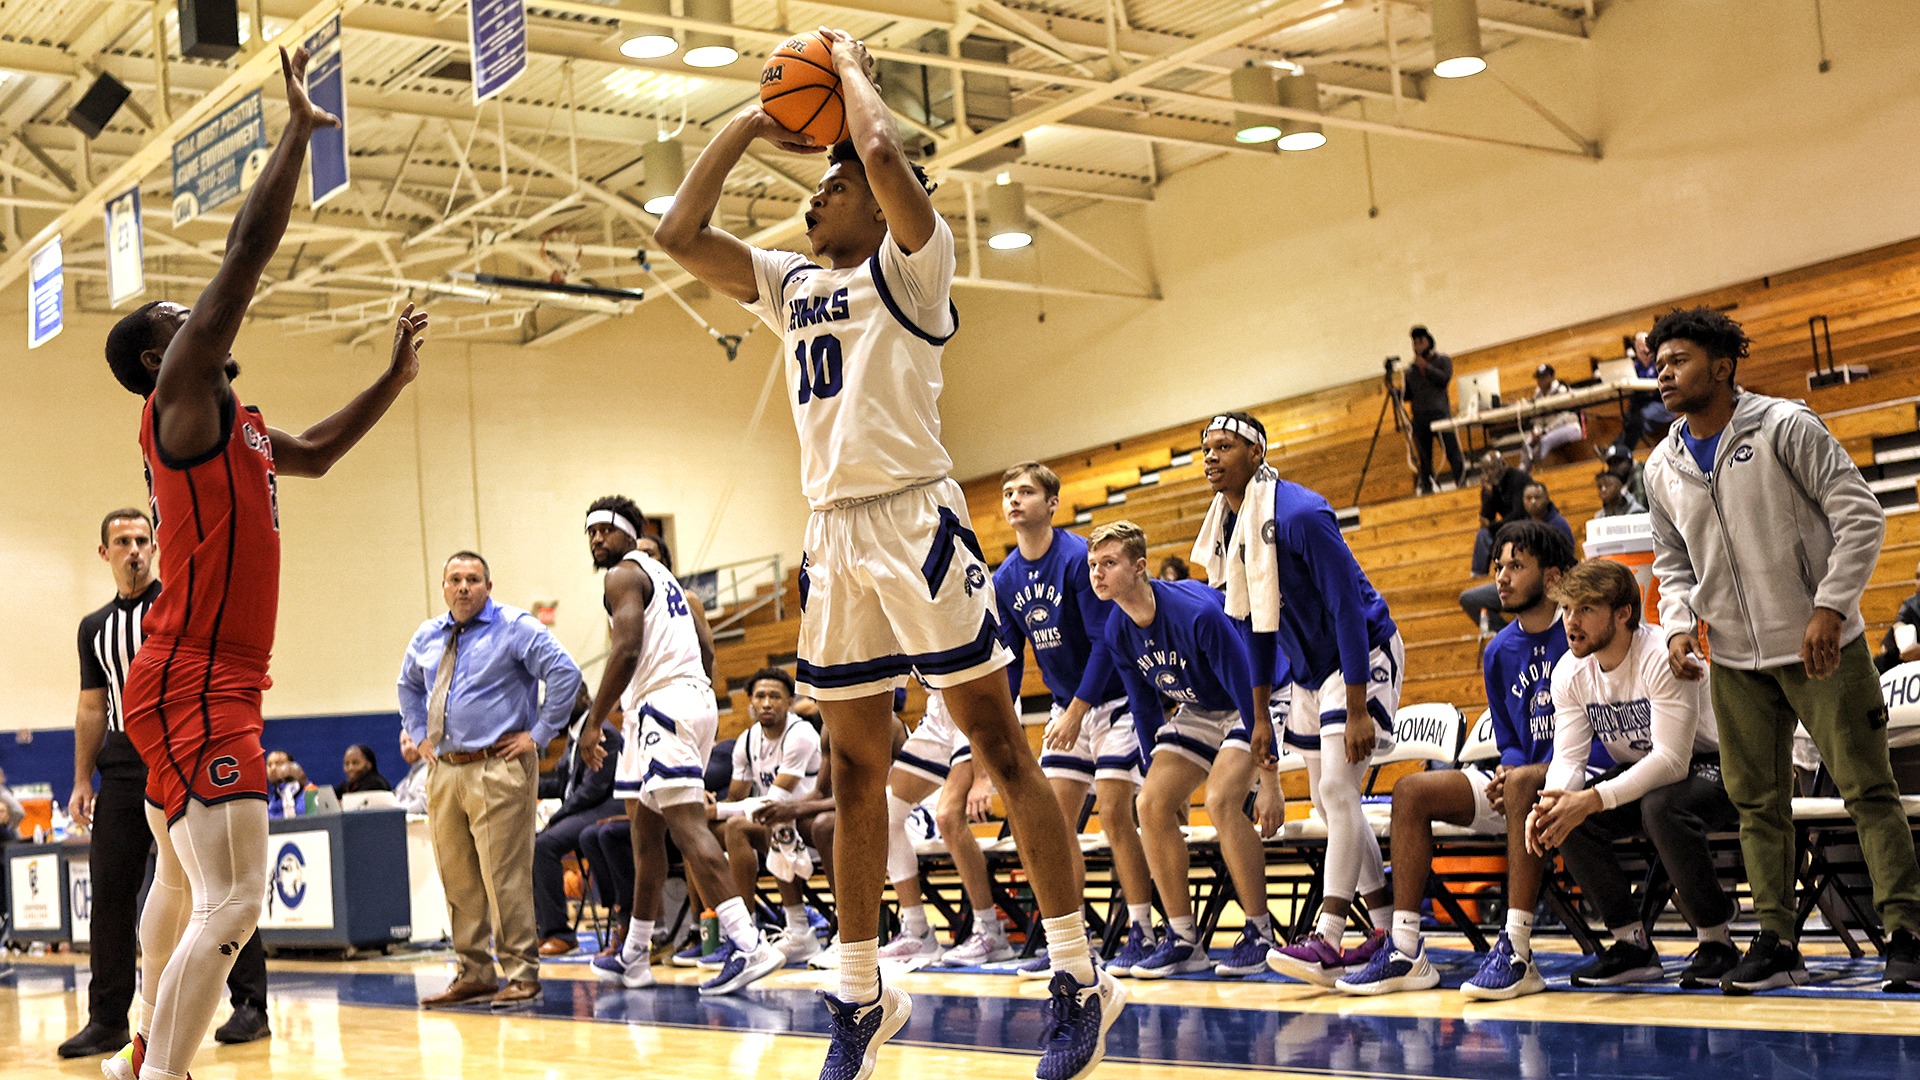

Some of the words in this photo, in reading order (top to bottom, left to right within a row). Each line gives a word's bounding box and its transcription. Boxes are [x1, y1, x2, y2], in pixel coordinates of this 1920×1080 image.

[761, 65, 783, 84] CAA
[795, 333, 843, 405] 10
[1013, 583, 1062, 611] CHOWAN
[1031, 627, 1062, 643] AWKS
[1511, 661, 1552, 698] CHOW
[1392, 717, 1448, 747] HOWAN
[208, 756, 240, 787] C
